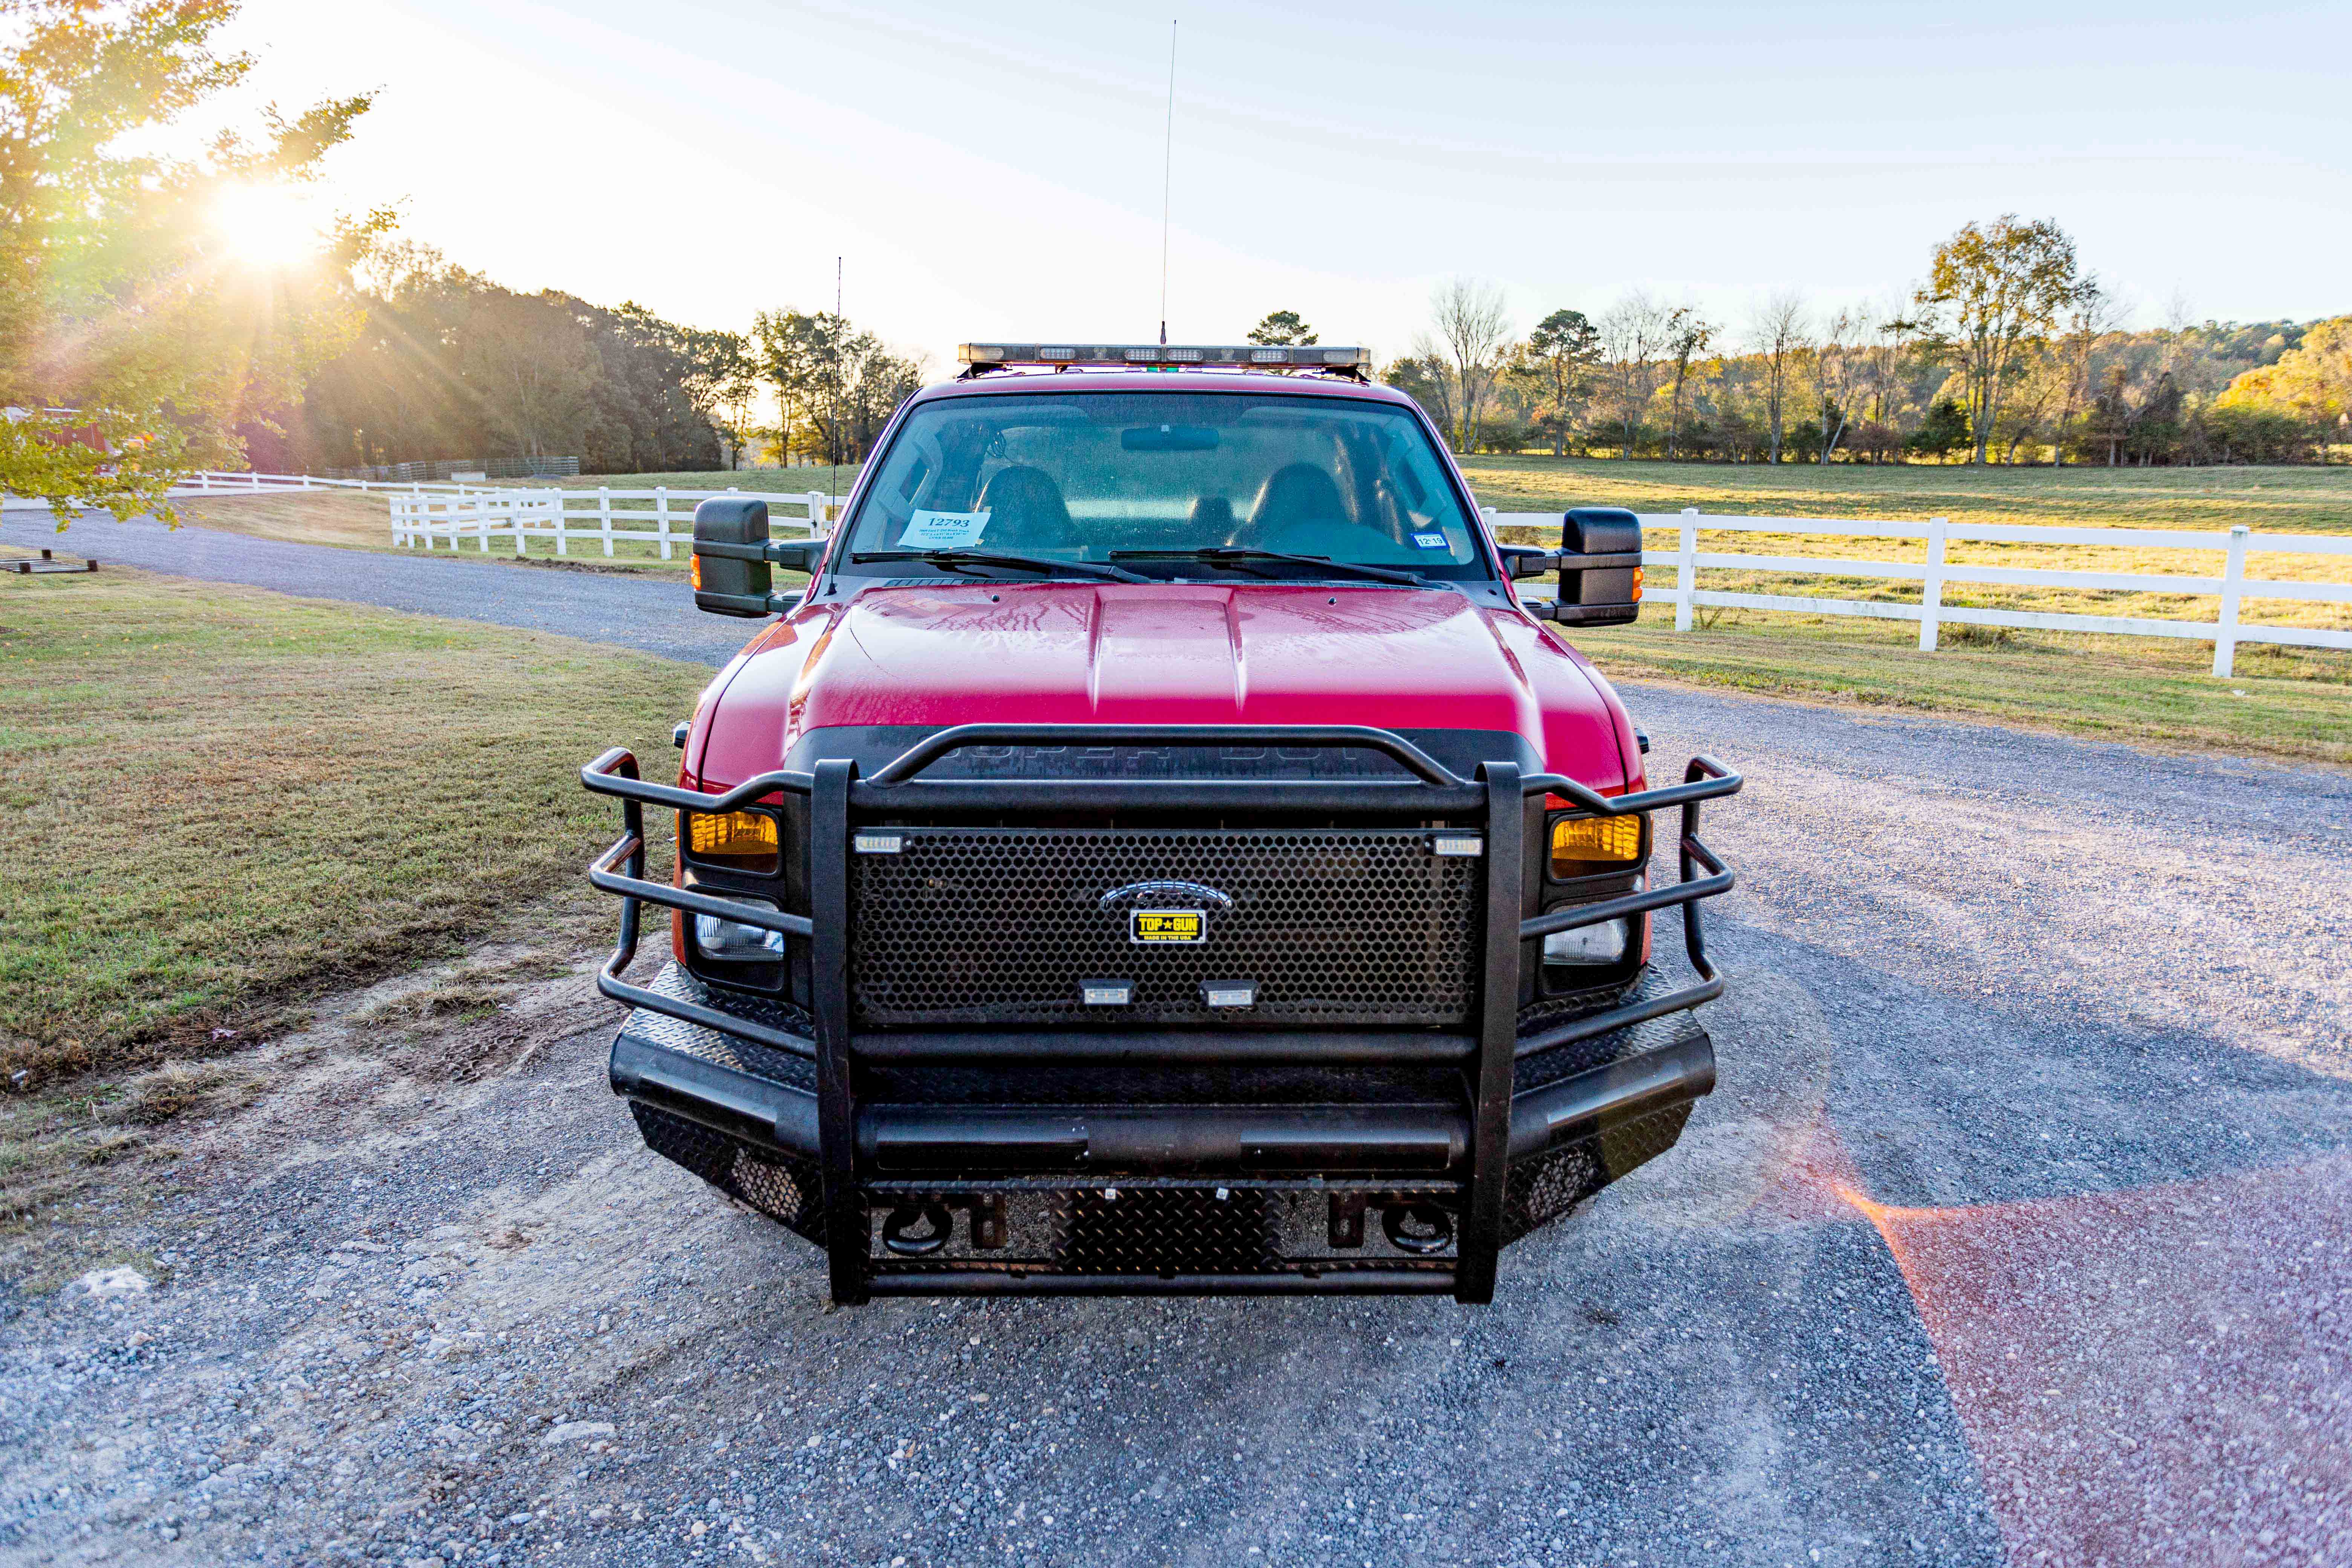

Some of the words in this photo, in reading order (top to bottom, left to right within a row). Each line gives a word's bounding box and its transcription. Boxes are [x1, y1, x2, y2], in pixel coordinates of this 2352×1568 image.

[928, 518, 970, 527] 12793
[1139, 917, 1162, 931] TOP
[1173, 917, 1197, 931] GUN
